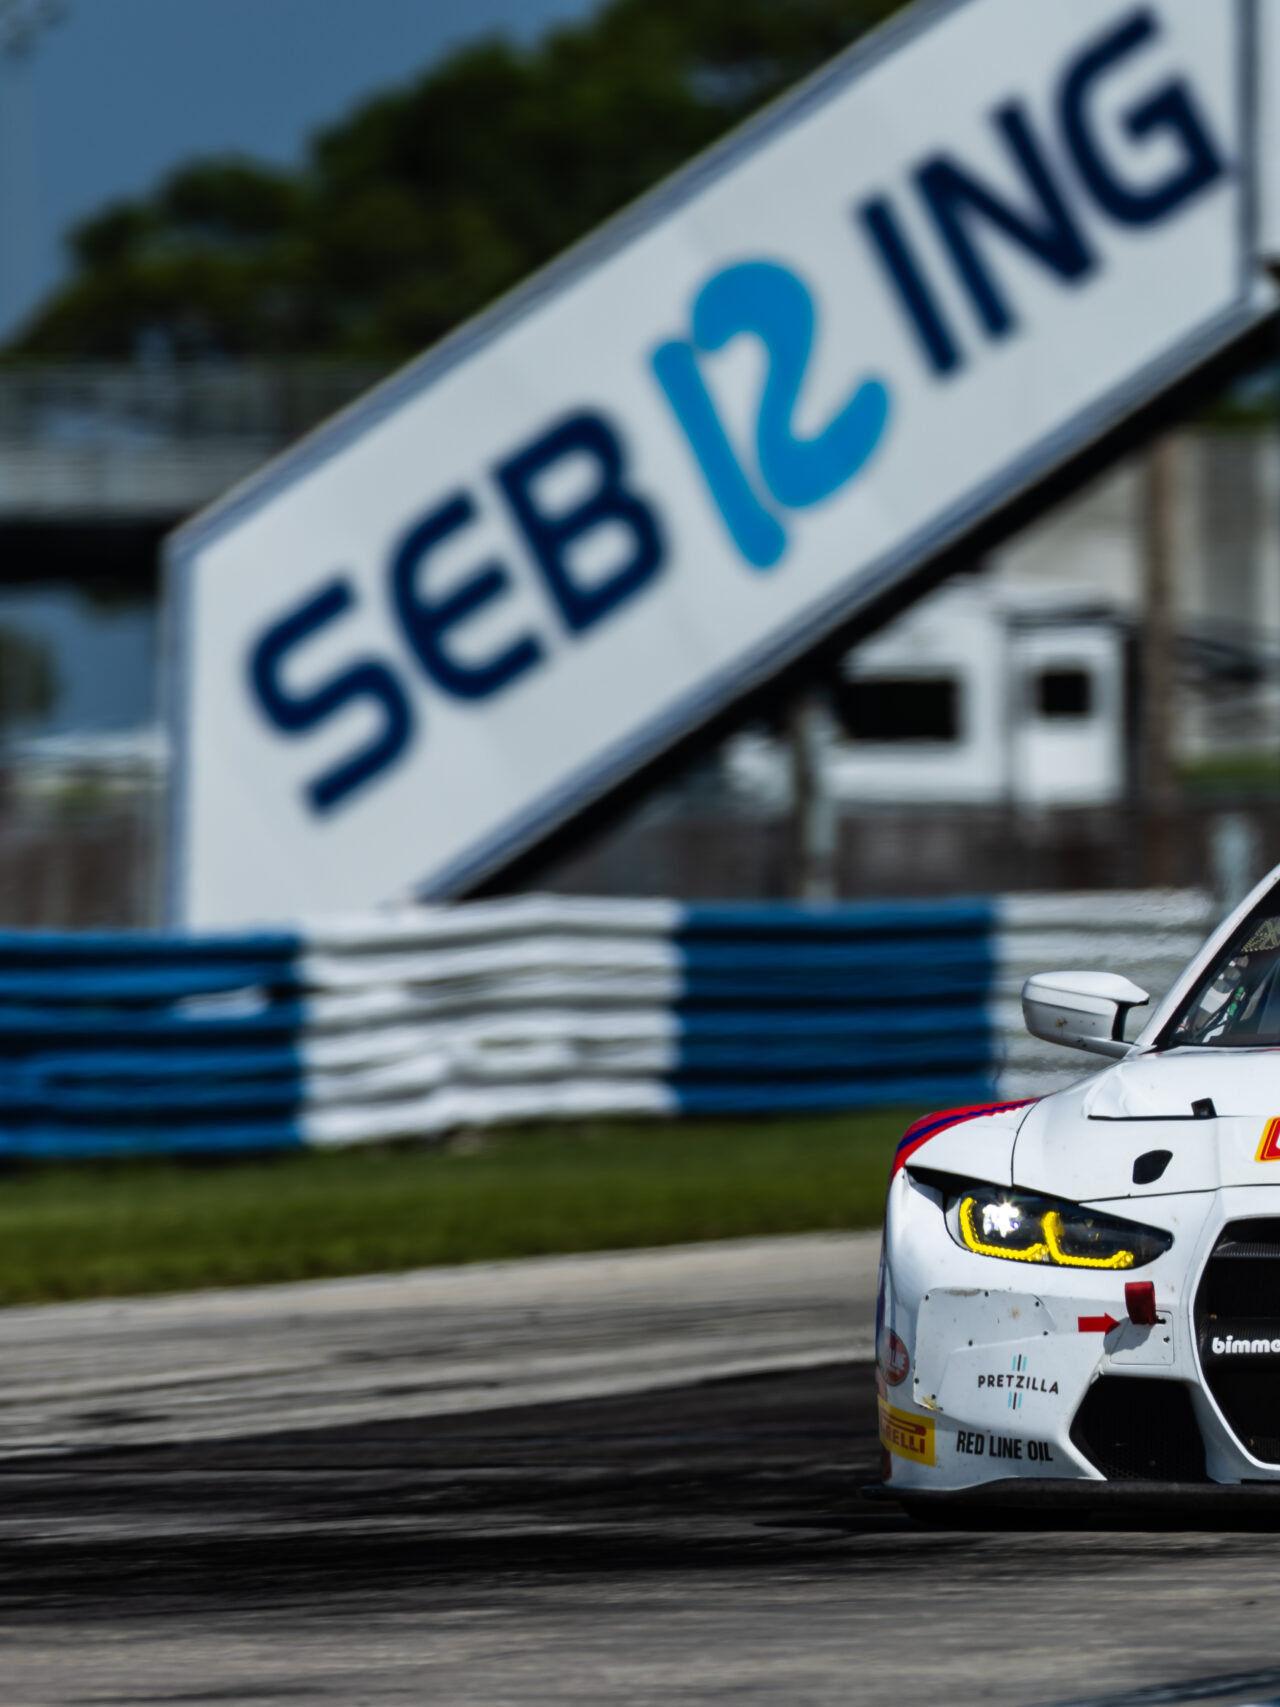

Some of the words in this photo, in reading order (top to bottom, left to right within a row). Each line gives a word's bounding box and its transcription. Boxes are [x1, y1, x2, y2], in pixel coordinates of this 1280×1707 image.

[246, 3, 1228, 822] SEBRING
[977, 1374, 1060, 1395] PRETZILLA
[956, 1430, 985, 1455] RED
[988, 1435, 1023, 1460] LINE
[1026, 1439, 1055, 1462] OIL
